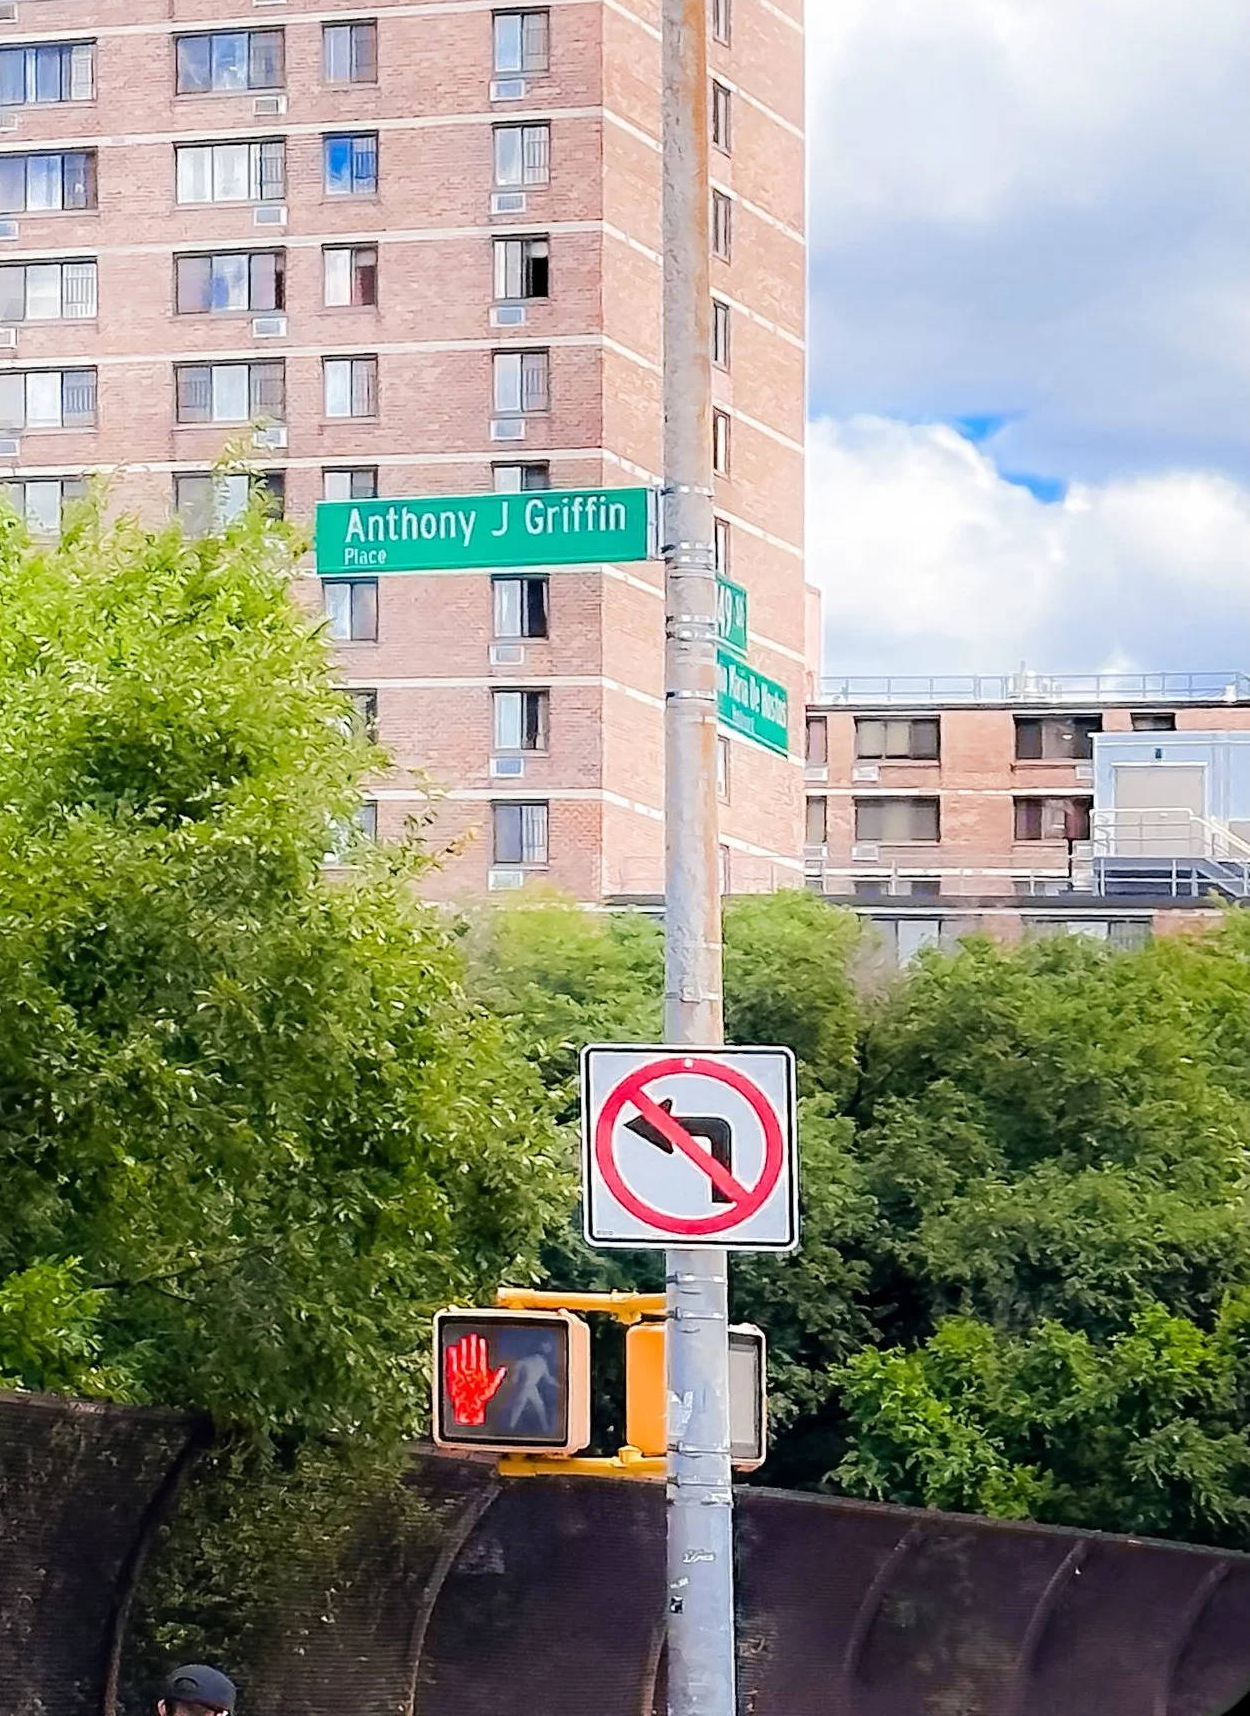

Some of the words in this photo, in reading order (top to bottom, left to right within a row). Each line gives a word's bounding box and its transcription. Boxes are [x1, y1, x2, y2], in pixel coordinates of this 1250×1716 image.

[344, 505, 476, 547] Anthony
[491, 501, 509, 537] J
[525, 495, 626, 535] Griffin
[344, 547, 387, 565] Place
